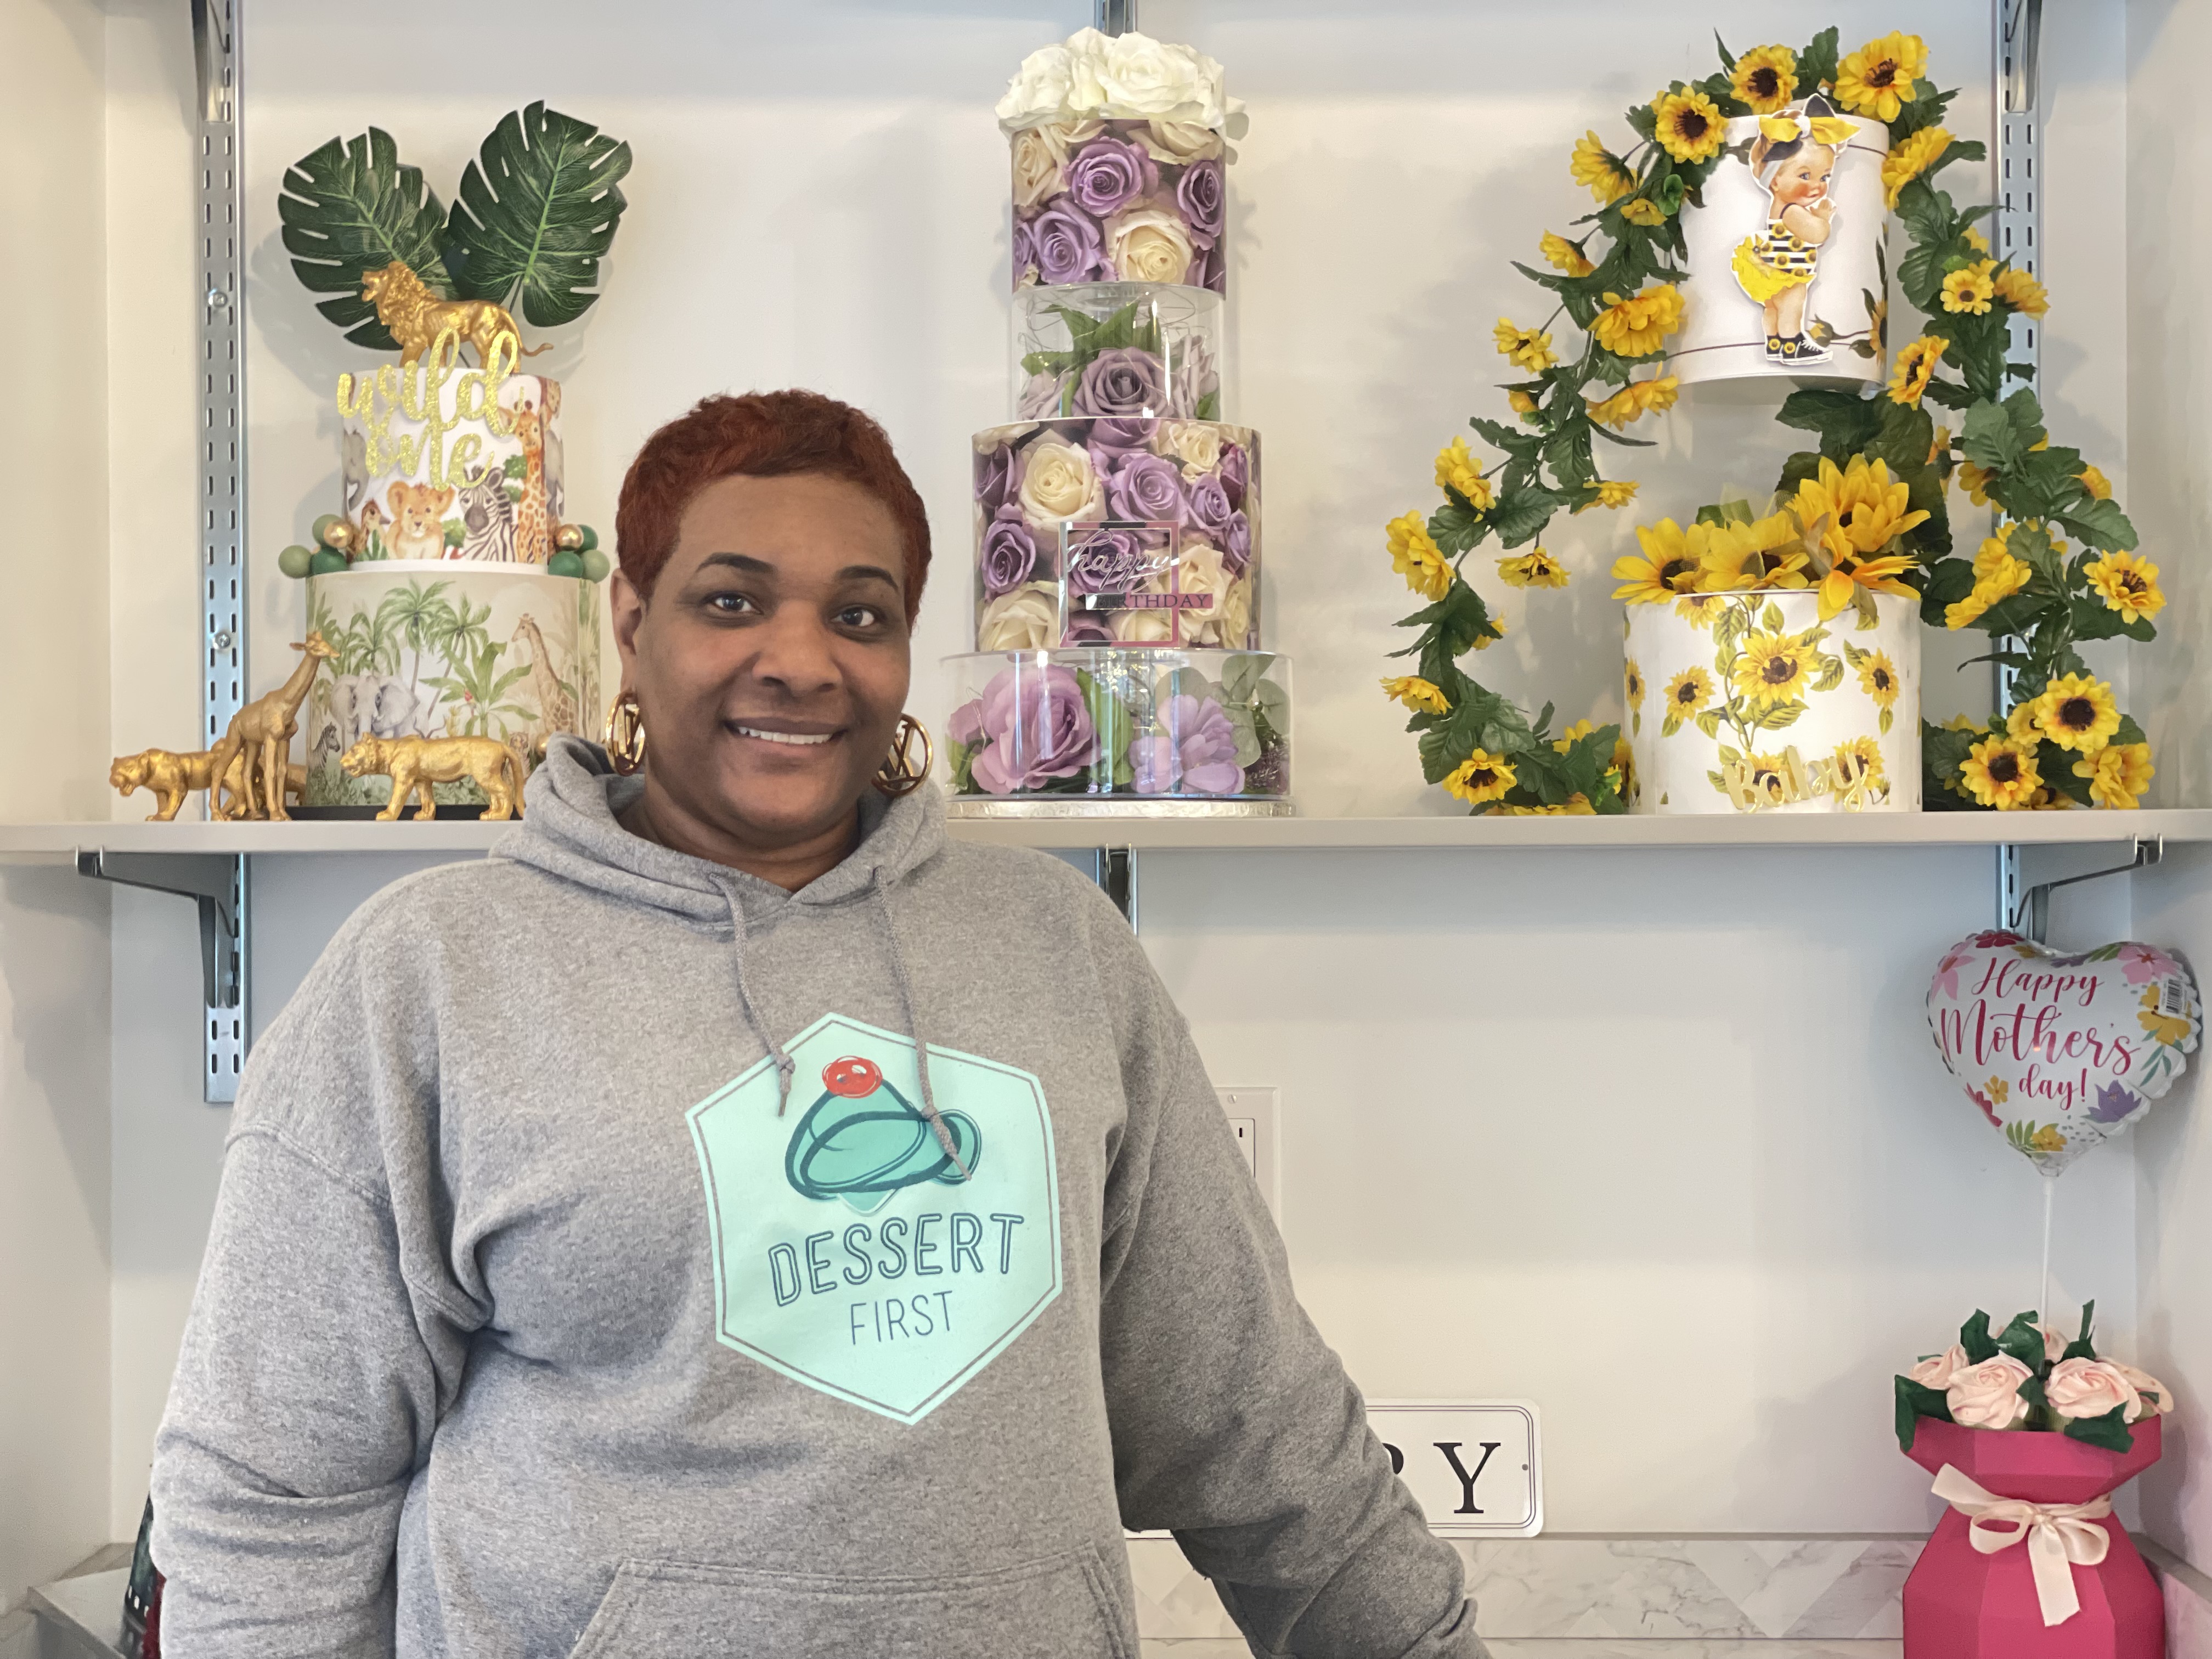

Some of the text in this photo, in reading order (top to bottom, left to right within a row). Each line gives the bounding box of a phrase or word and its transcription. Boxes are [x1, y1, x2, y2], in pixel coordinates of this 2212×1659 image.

[336, 327, 524, 437] wild
[365, 425, 495, 492] one
[1066, 528, 1181, 594] happy
[1722, 744, 1869, 814] Baby
[1971, 957, 2105, 1007] Happy
[1940, 998, 2142, 1075] Mother's
[2018, 1063, 2088, 1110] day!
[768, 1212, 1024, 1307] DESSERT
[850, 1290, 953, 1346] FIRST
